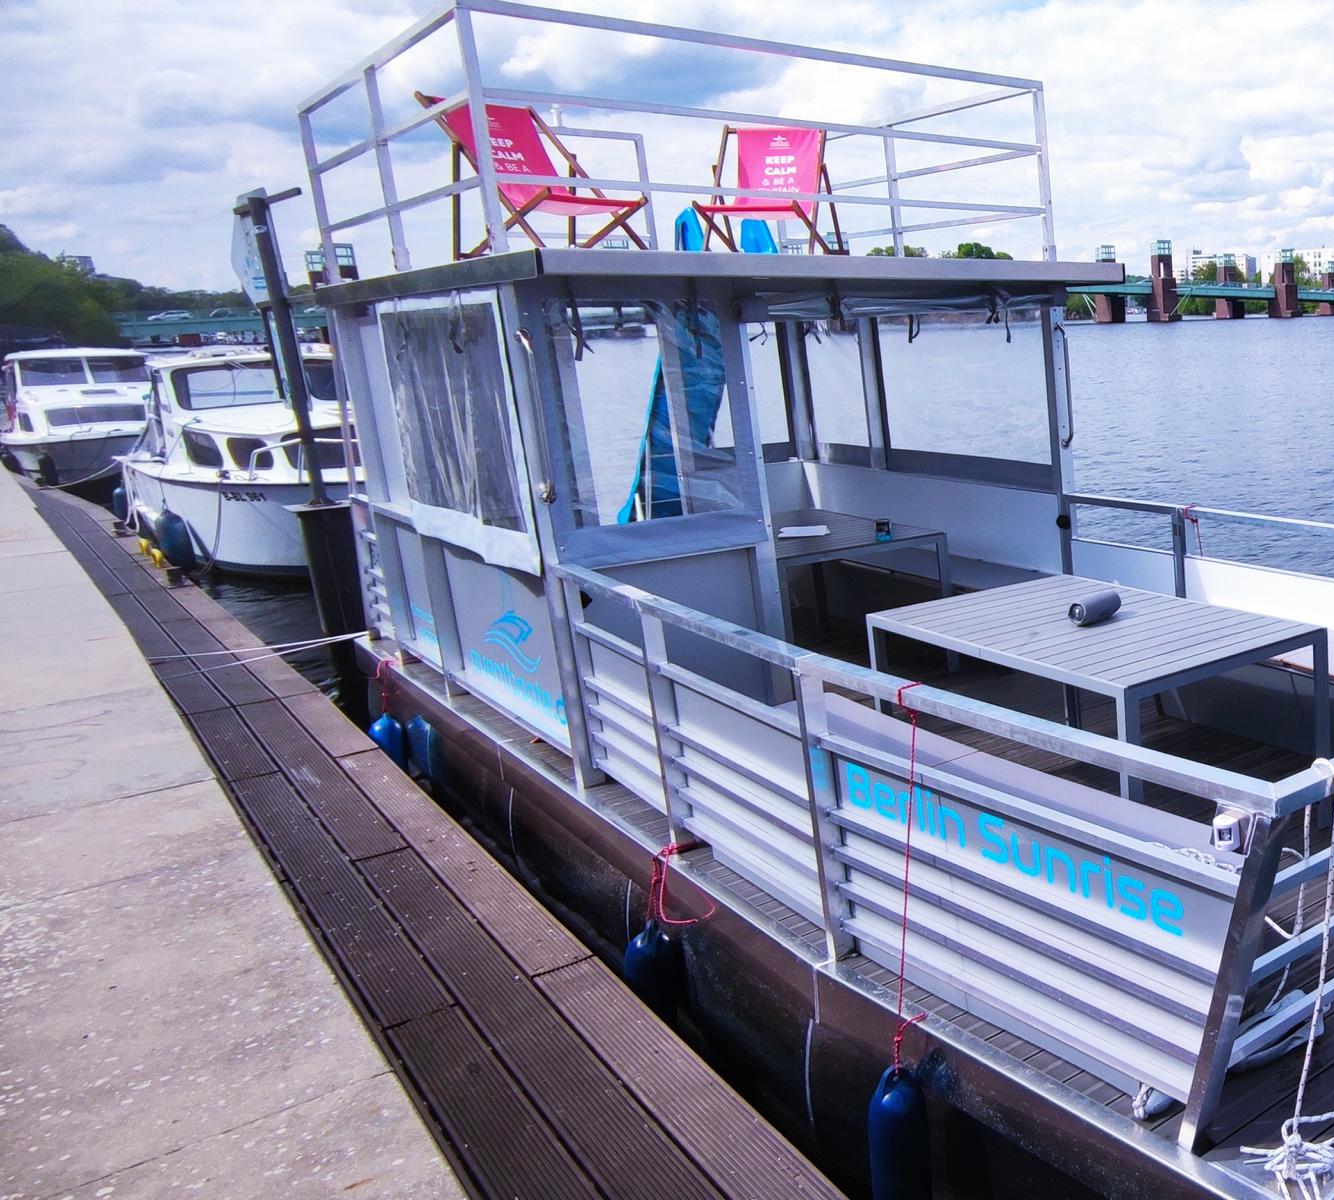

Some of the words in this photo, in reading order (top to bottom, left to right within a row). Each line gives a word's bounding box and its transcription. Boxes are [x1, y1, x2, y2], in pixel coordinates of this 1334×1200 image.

[765, 155, 795, 165] KEEP
[764, 166, 797, 176] CALM
[773, 178, 785, 186] BE
[846, 761, 966, 849] Berlin
[978, 812, 1185, 938] Sunrise
